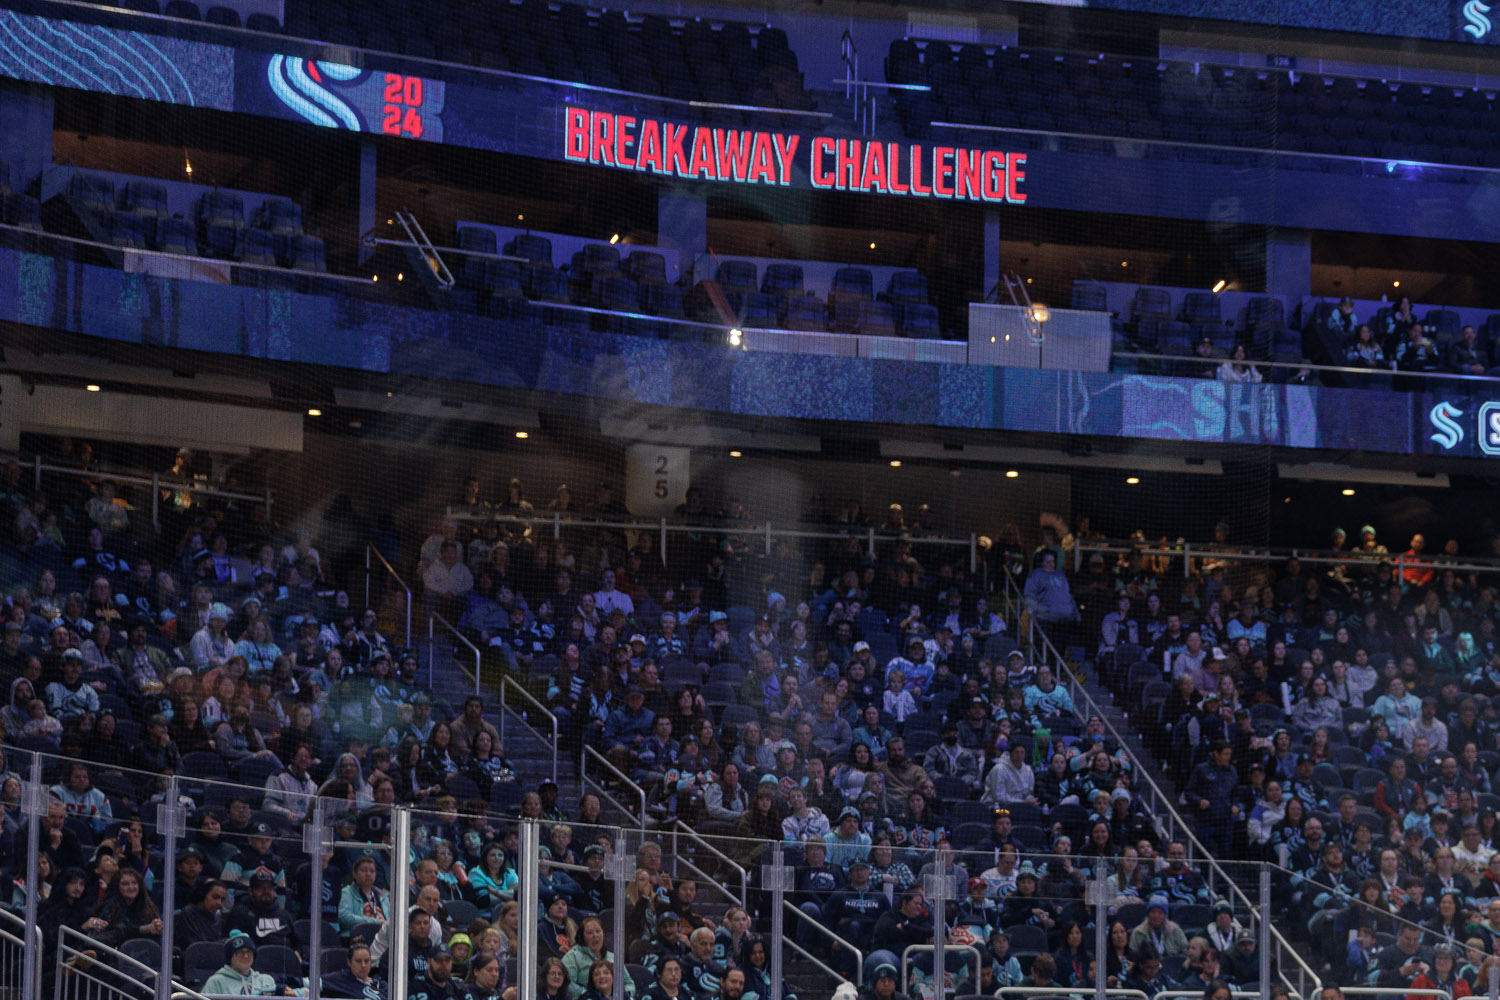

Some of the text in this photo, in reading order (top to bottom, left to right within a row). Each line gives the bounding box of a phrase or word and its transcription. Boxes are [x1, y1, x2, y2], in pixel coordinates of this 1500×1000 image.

[384, 73, 423, 107] 20
[382, 104, 423, 139] 24
[565, 107, 1028, 204] BREAKAWAY CHALLENGE
